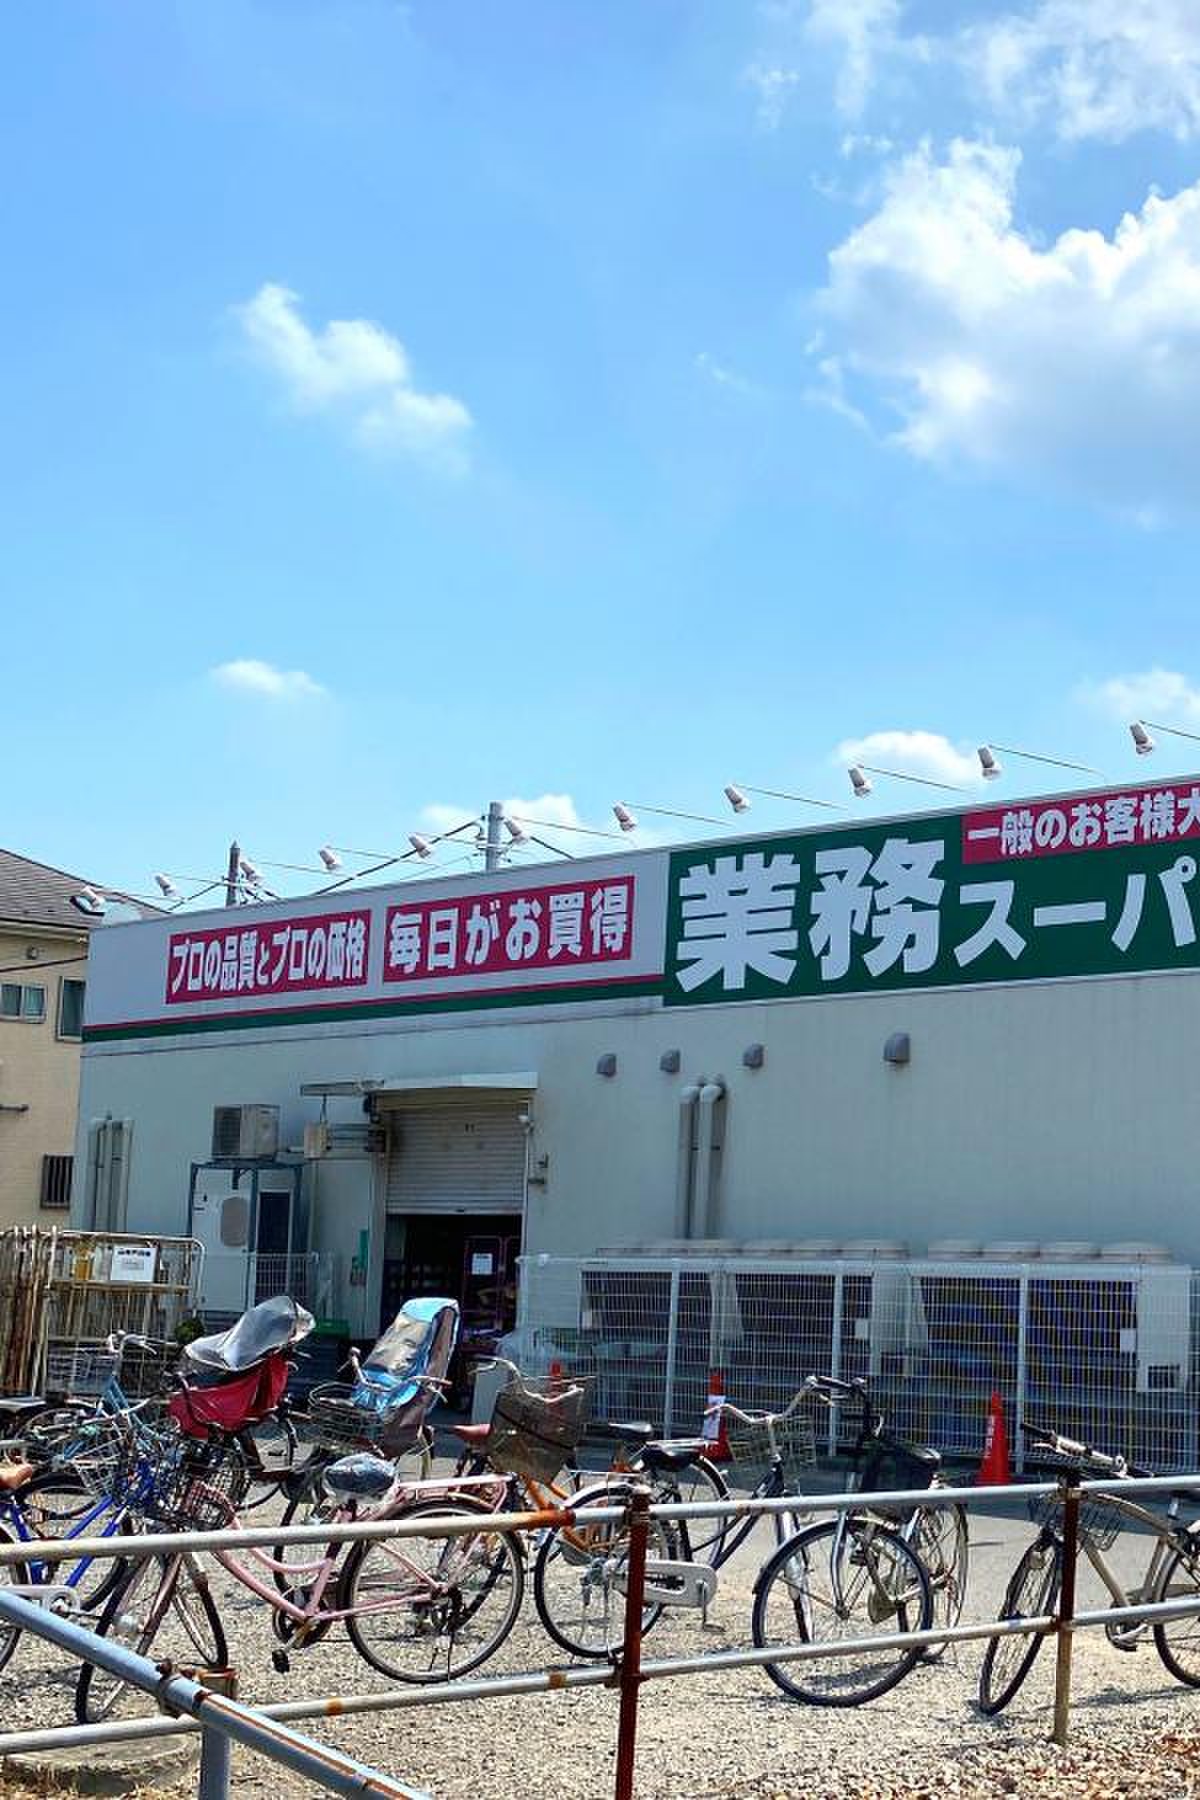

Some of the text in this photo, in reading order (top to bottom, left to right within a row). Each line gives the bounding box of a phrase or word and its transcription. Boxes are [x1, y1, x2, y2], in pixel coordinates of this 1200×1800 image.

[172, 918, 366, 994] プロの品質とプロの価格
[387, 884, 628, 973] 毎日がお買得
